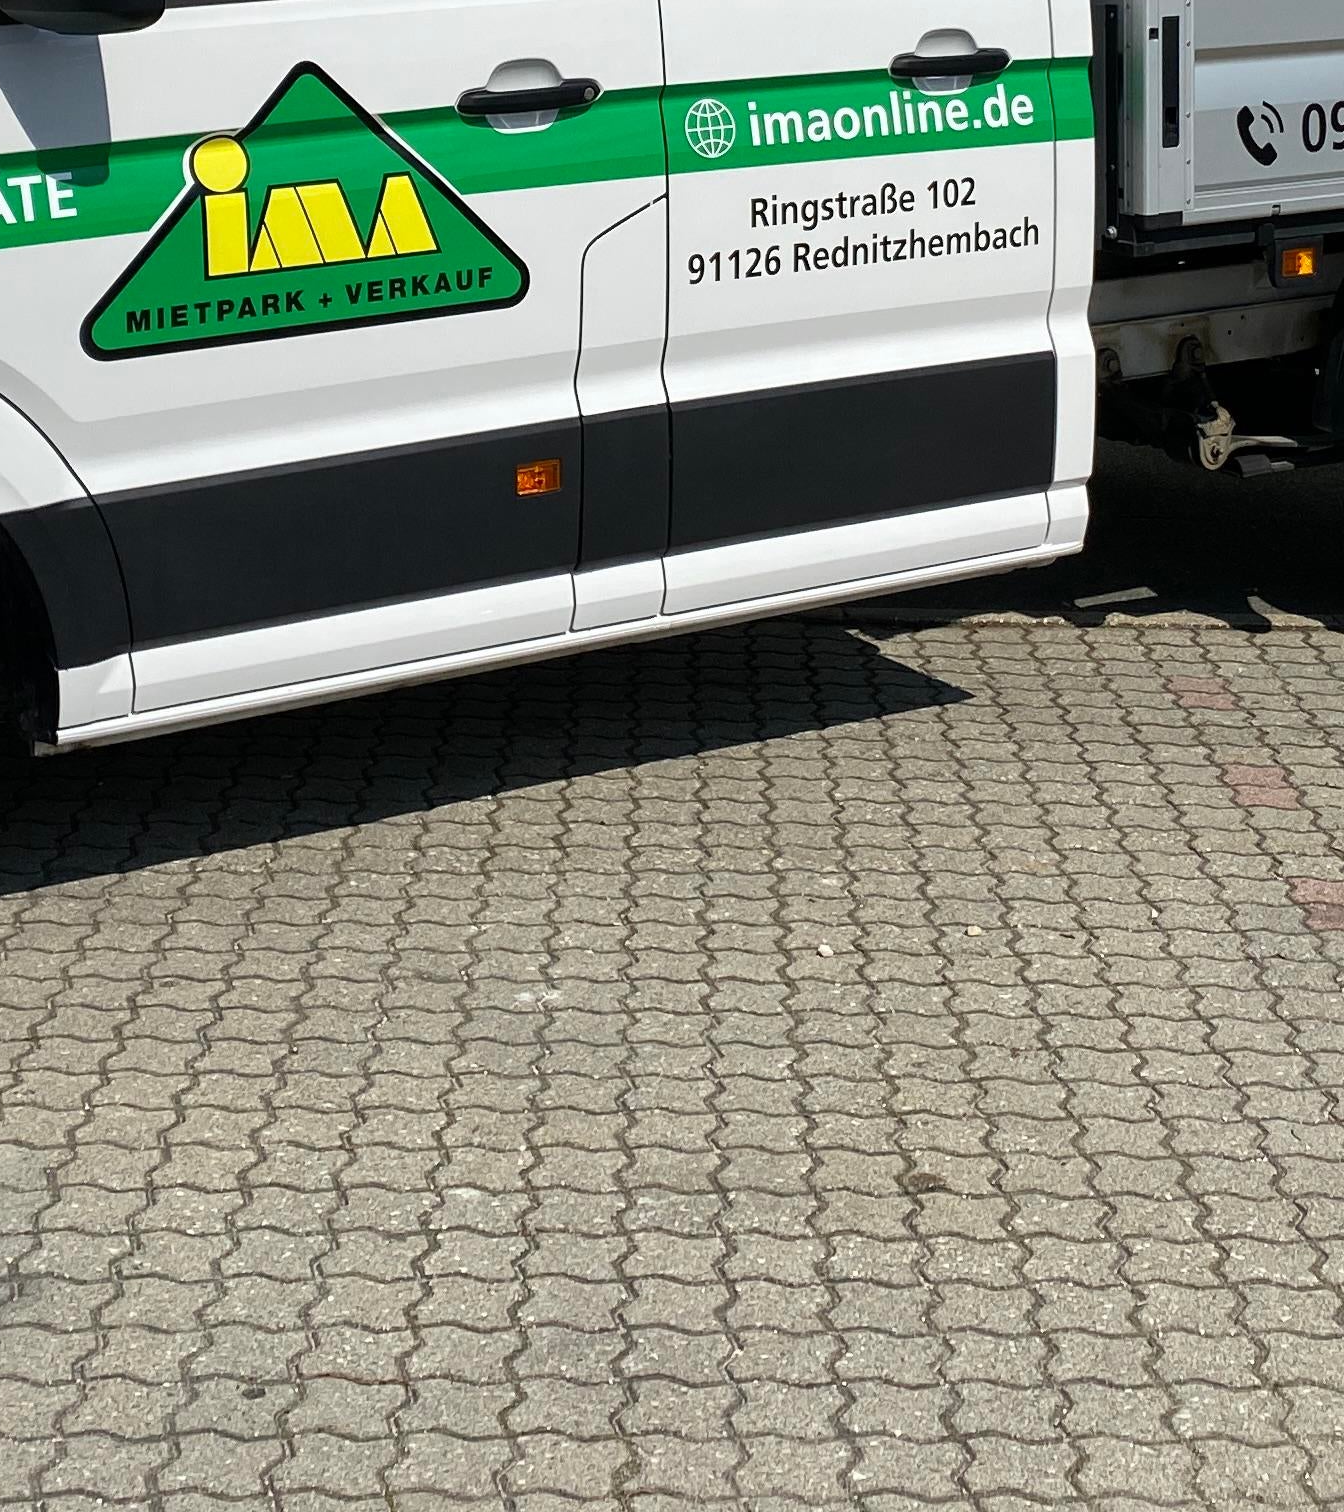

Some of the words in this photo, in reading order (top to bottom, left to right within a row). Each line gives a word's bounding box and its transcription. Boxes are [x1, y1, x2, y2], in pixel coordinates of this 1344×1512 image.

[748, 84, 1034, 147] imaonline.de
[750, 183, 915, 231] Ringstraße
[927, 176, 976, 210] 102
[687, 245, 781, 285] 91126
[793, 216, 1040, 273] Rednitzhembach
[125, 289, 305, 333] MIETPARK
[346, 266, 494, 305] VERKAUF
